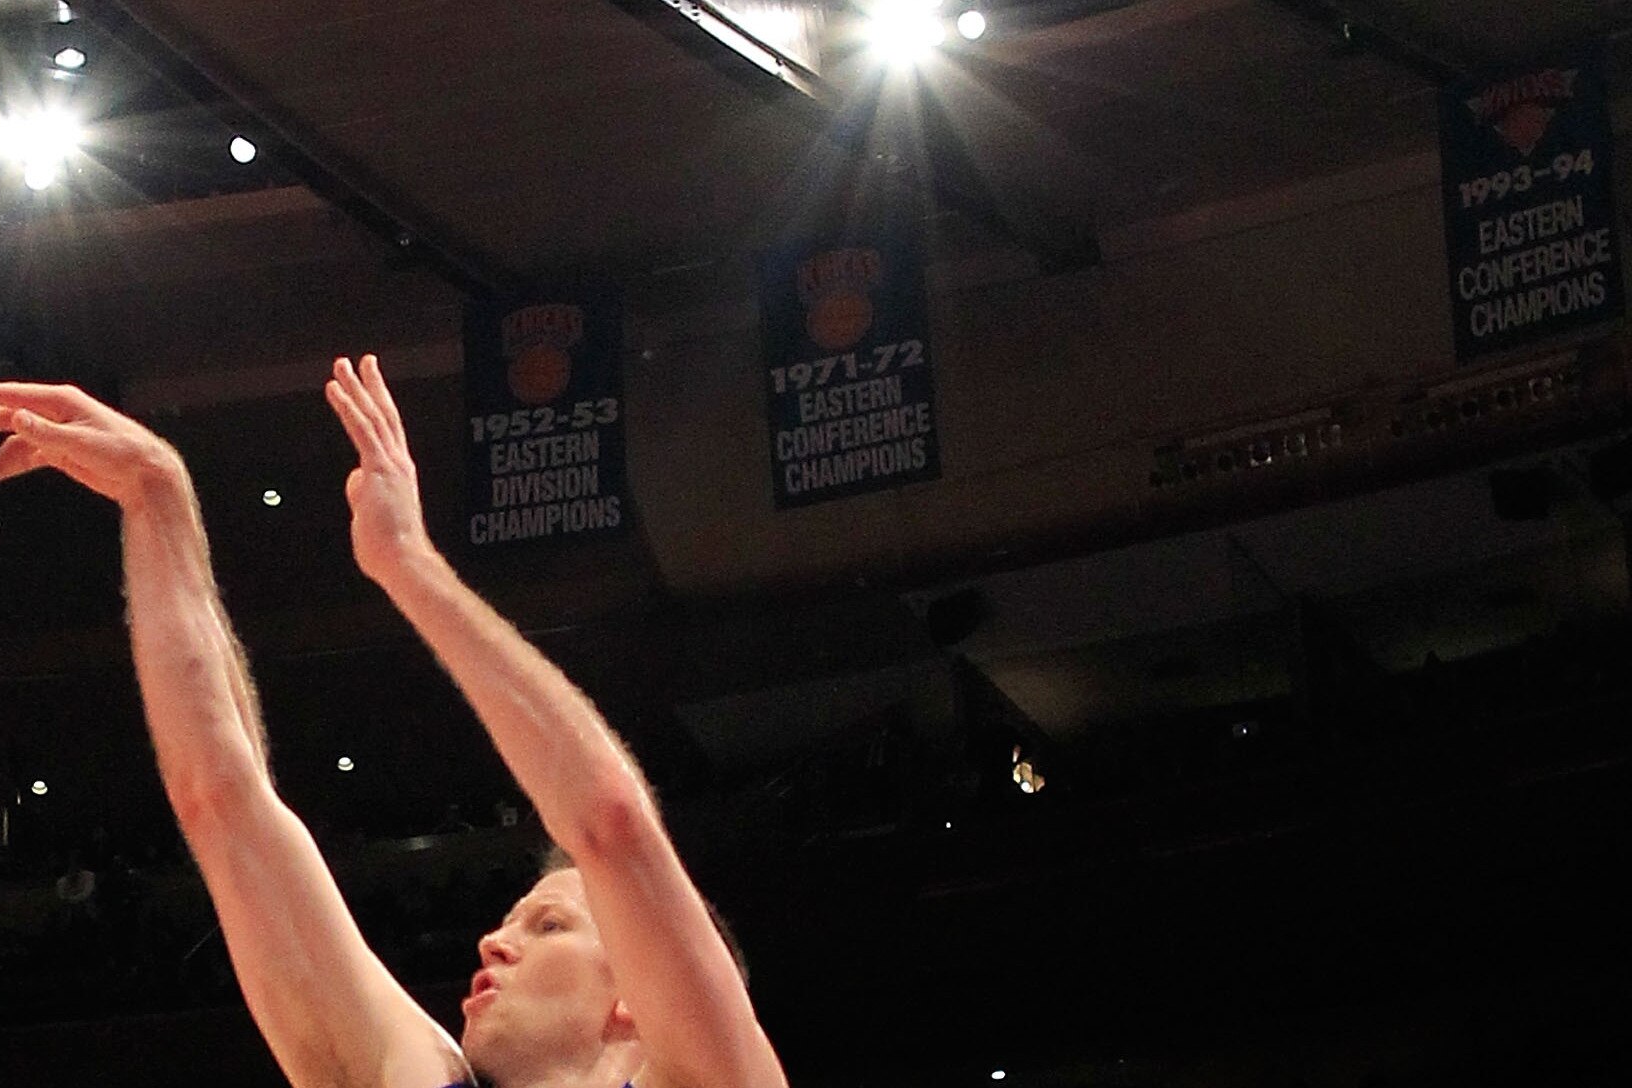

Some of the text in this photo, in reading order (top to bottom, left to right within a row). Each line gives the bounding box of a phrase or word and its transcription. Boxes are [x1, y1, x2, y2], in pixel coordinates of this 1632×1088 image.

[1459, 150, 1594, 208] 1993-94
[1479, 194, 1584, 254] EASTERN
[1458, 227, 1611, 300] CONFERENCE
[1470, 270, 1605, 337] CHAMPIONS
[771, 340, 924, 394] 1971-72
[471, 398, 619, 442] 1952-53
[799, 375, 902, 422] EASTERN
[491, 430, 599, 474] EASTERN
[777, 402, 932, 461] CONFERENCE
[492, 464, 598, 507] DIVISION
[786, 439, 925, 494] CHAMPIONS
[470, 497, 621, 545] CHAMPIONS
